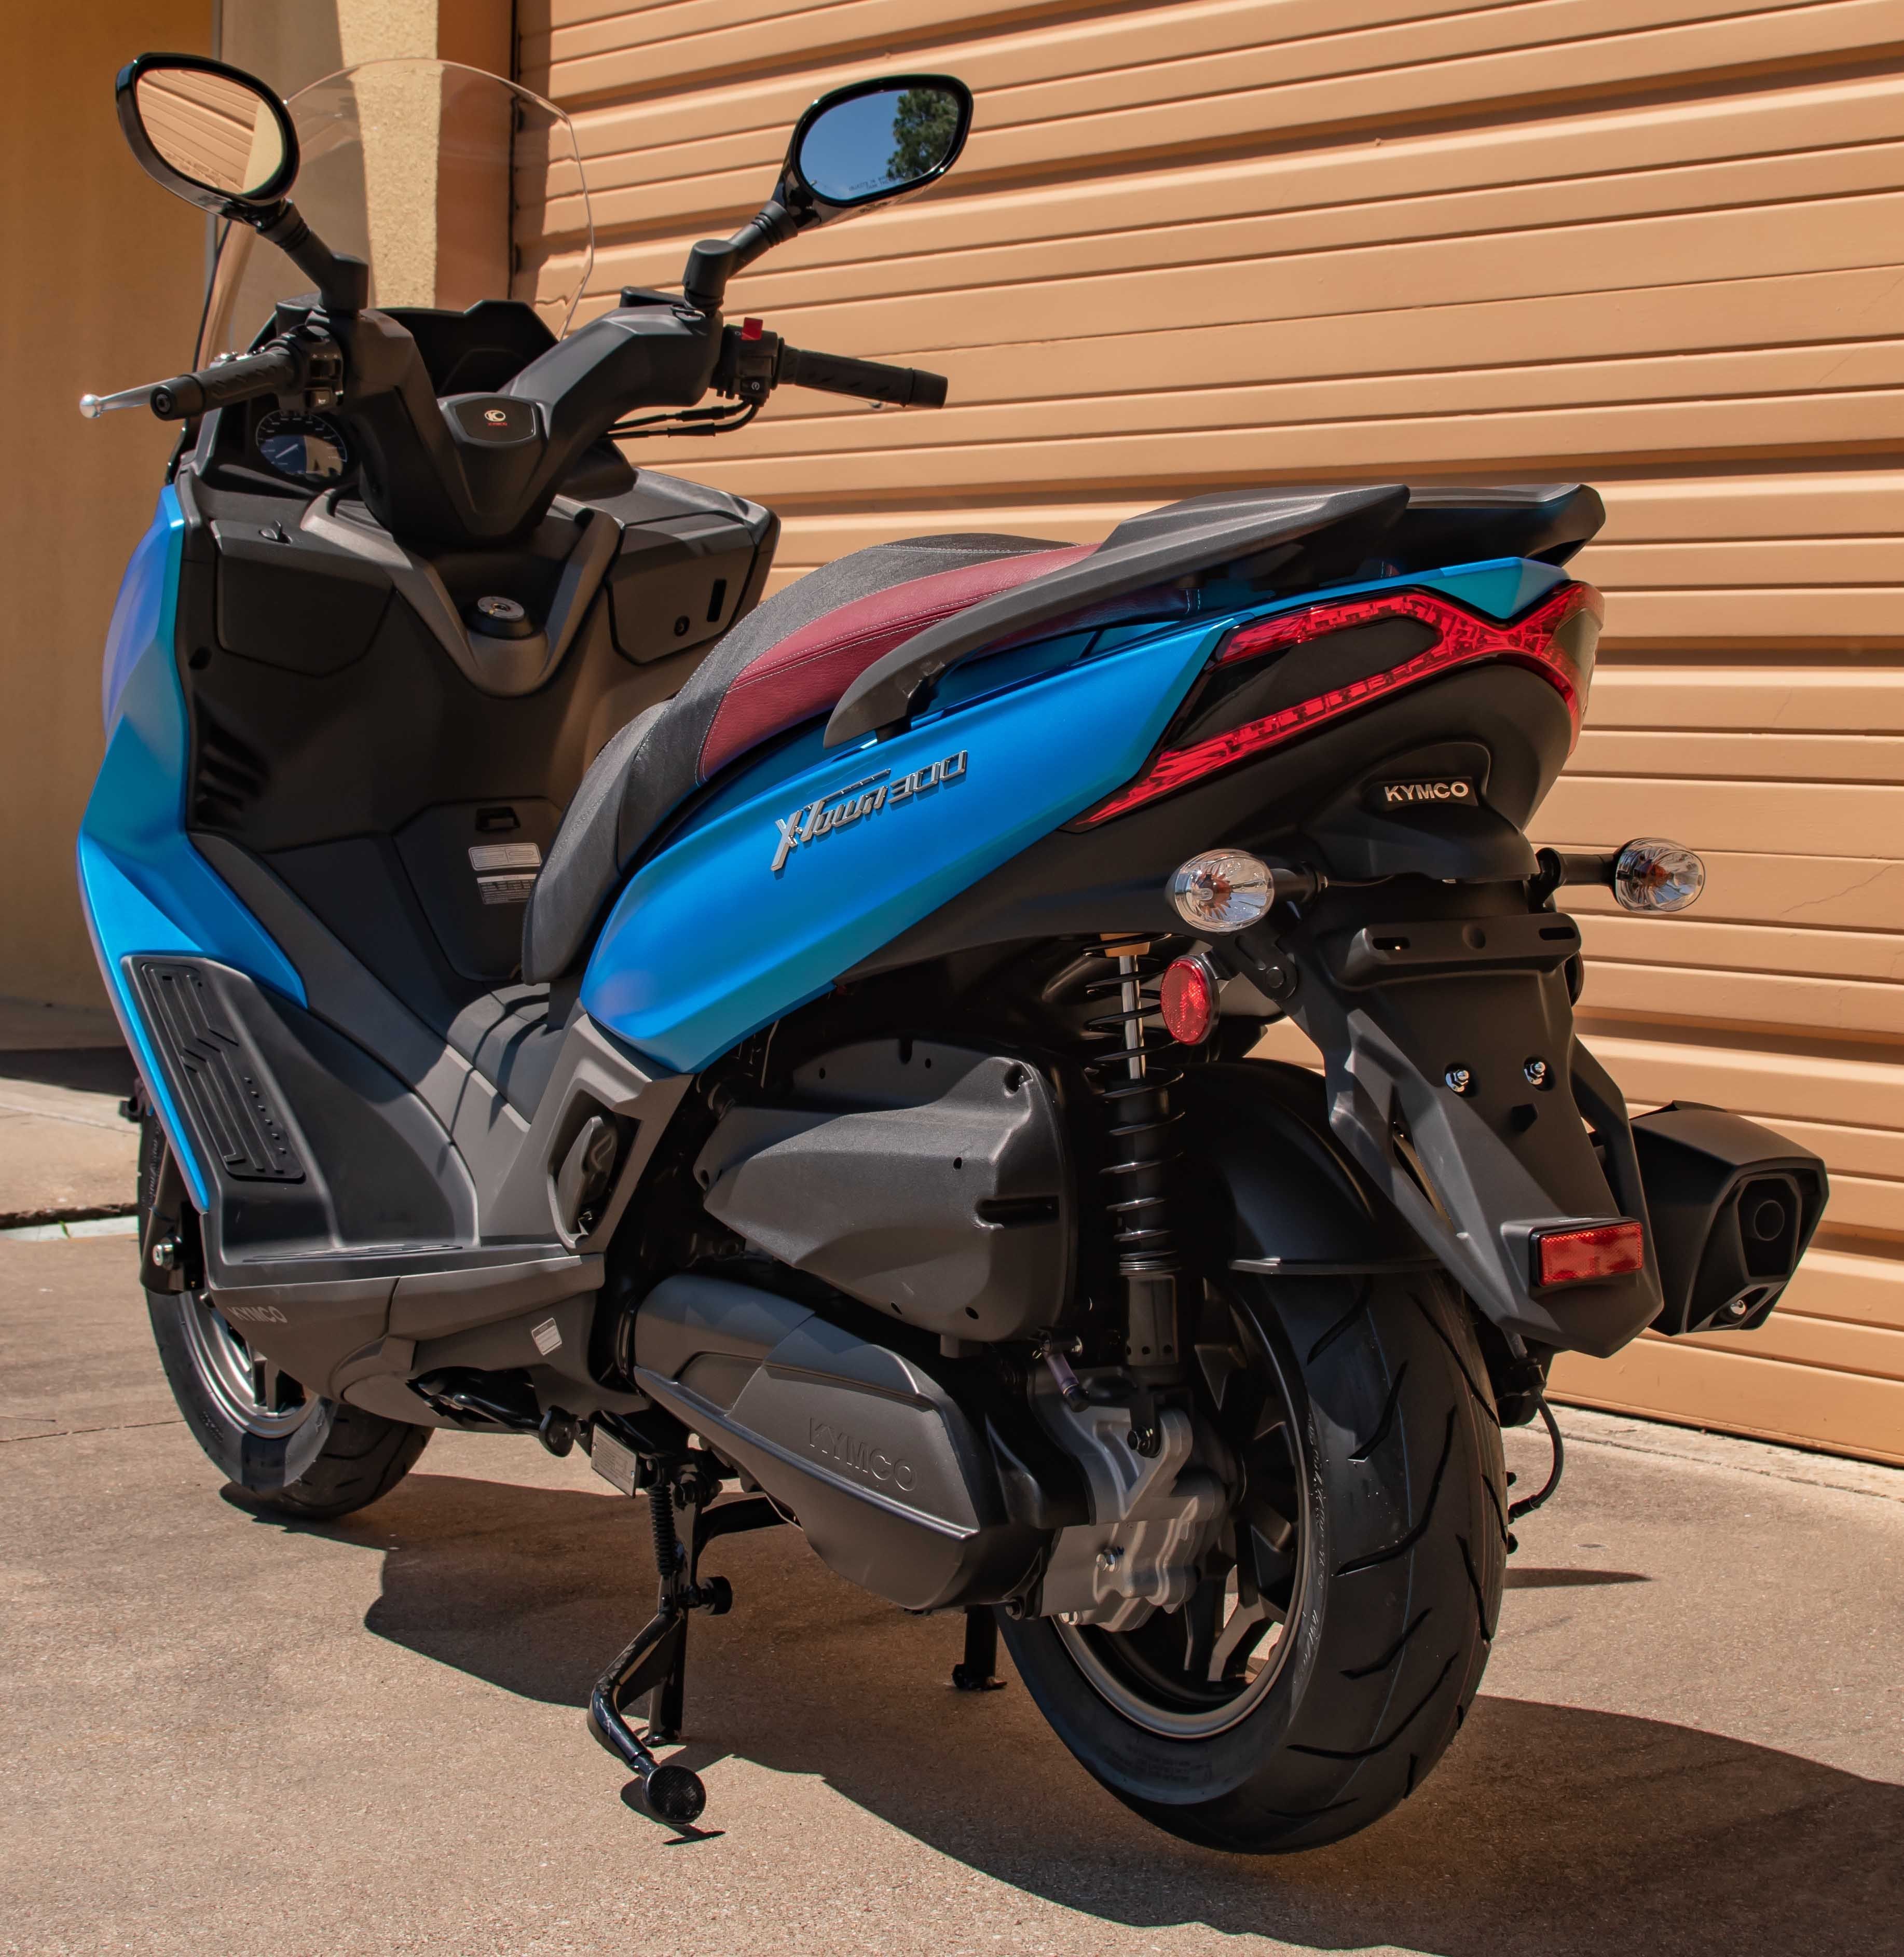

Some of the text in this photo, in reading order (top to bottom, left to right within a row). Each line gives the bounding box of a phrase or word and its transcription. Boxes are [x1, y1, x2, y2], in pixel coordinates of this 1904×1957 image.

[888, 750, 968, 804] 300
[1384, 781, 1469, 802] KYMCO
[226, 1306, 287, 1323] KYMCO
[810, 1417, 917, 1491] KYMCO
